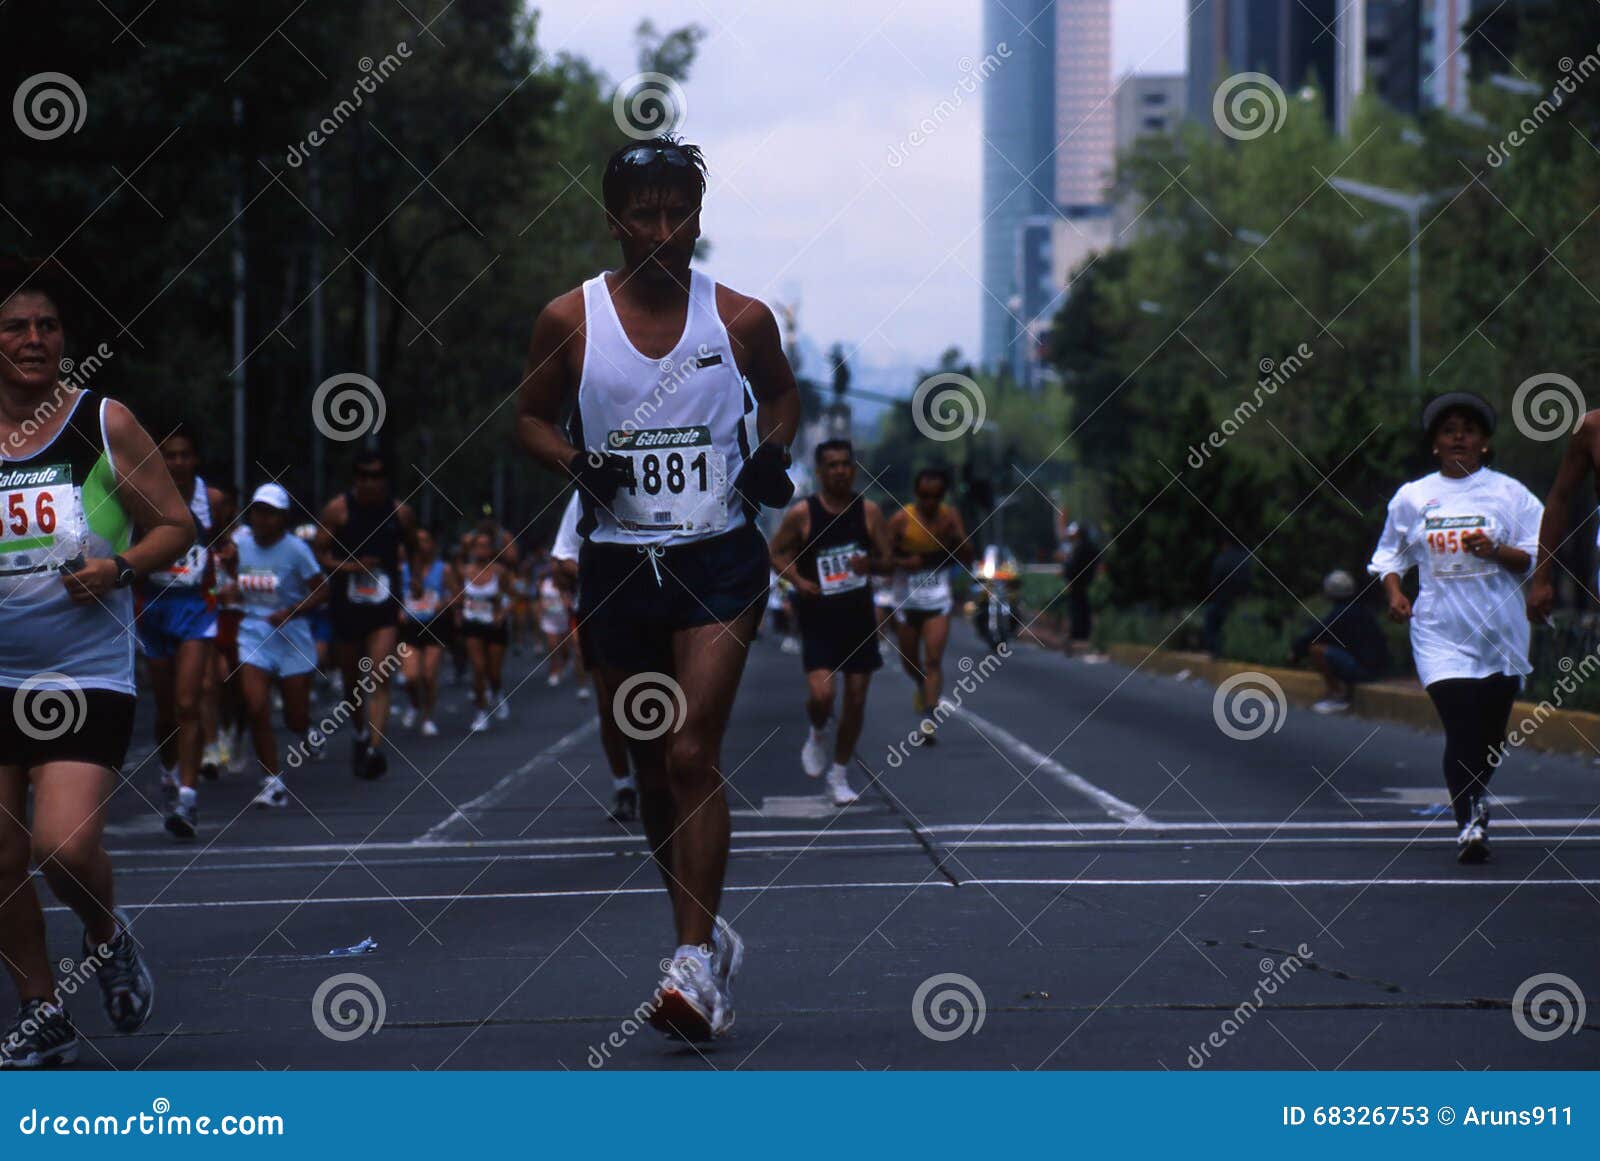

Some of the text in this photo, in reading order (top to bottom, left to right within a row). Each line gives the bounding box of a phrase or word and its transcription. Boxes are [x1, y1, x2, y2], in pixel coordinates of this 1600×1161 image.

[635, 429, 700, 446] Gatorade
[0, 467, 57, 488] atorade
[0, 491, 57, 538] 56
